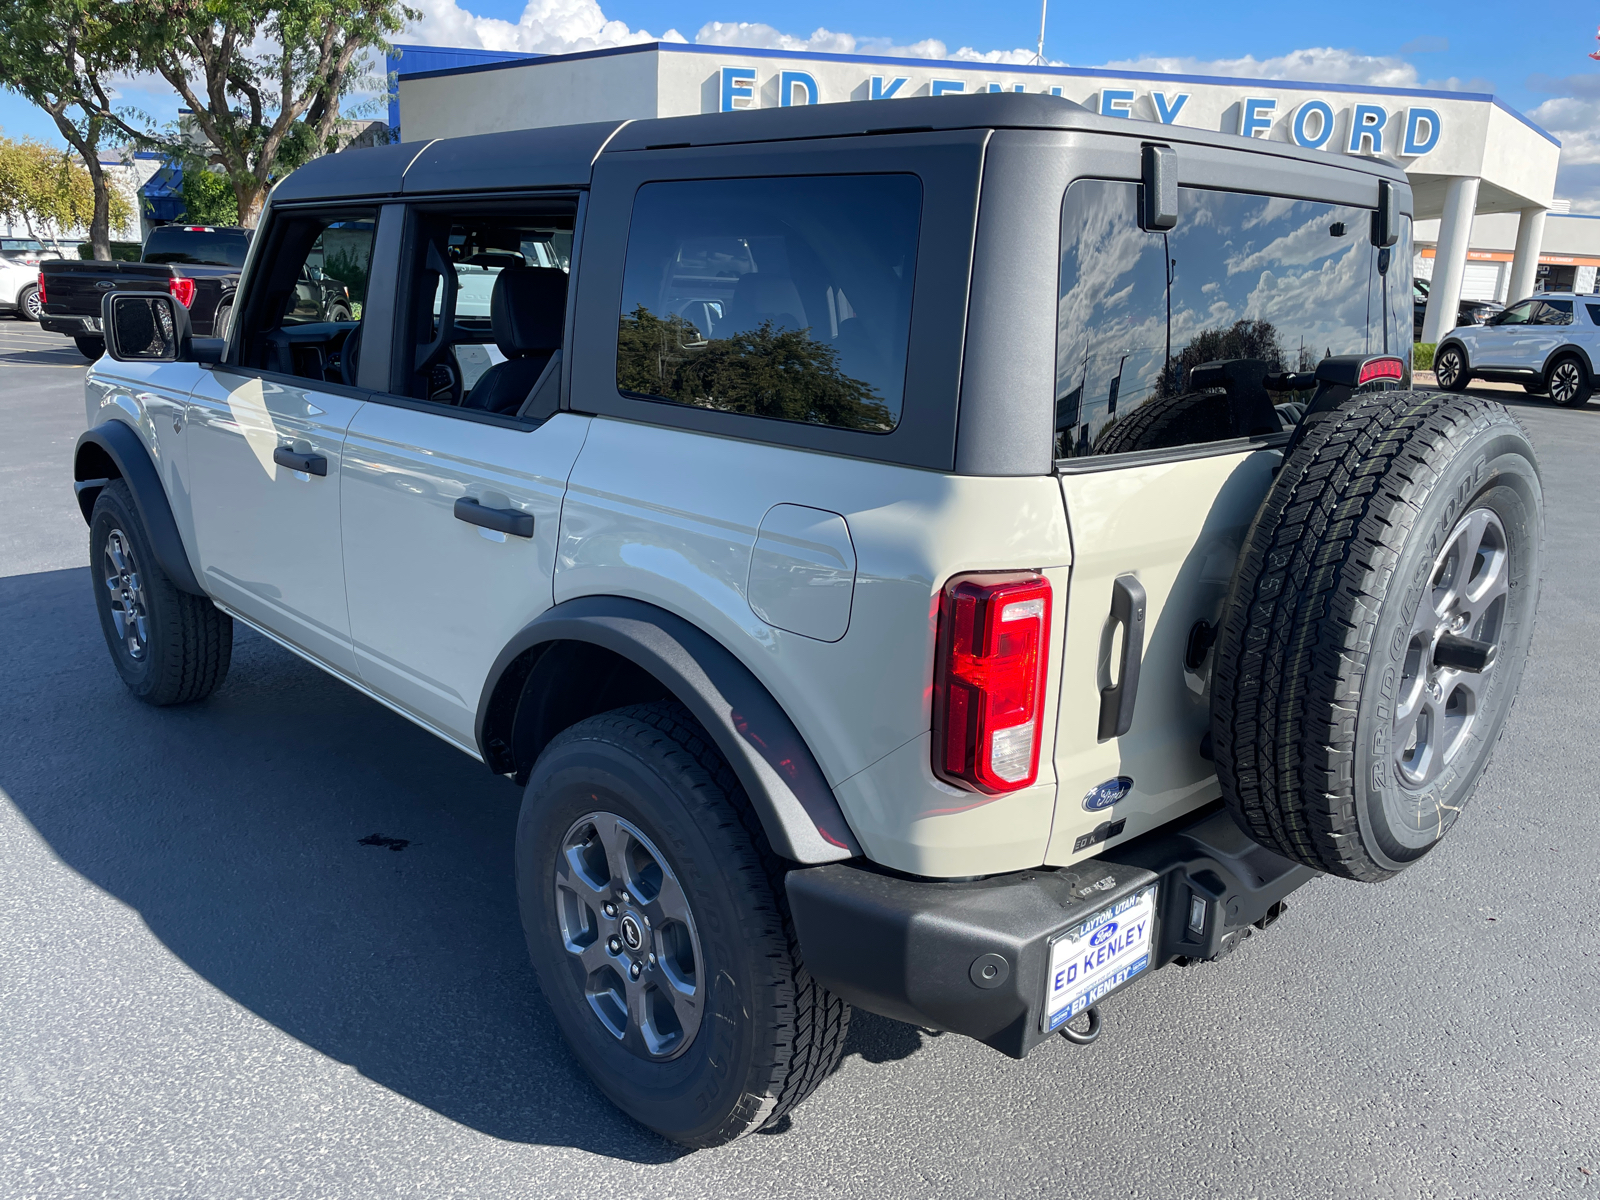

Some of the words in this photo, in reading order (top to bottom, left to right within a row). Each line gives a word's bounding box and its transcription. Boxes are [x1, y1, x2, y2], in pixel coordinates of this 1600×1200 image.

[719, 66, 820, 113] ED
[869, 74, 1193, 125] KEY
[1240, 96, 1443, 156] FORD
[1371, 454, 1487, 792] BRIDGESTONE
[1096, 786, 1125, 807] Ford
[1074, 838, 1088, 851] ED
[1080, 911, 1114, 936] LAYTON,
[1115, 894, 1138, 917] UTAH
[1054, 962, 1078, 991] ED
[1084, 920, 1146, 975] KENLEY
[1071, 995, 1087, 1015] ED
[1088, 966, 1131, 1001] KENLEY
